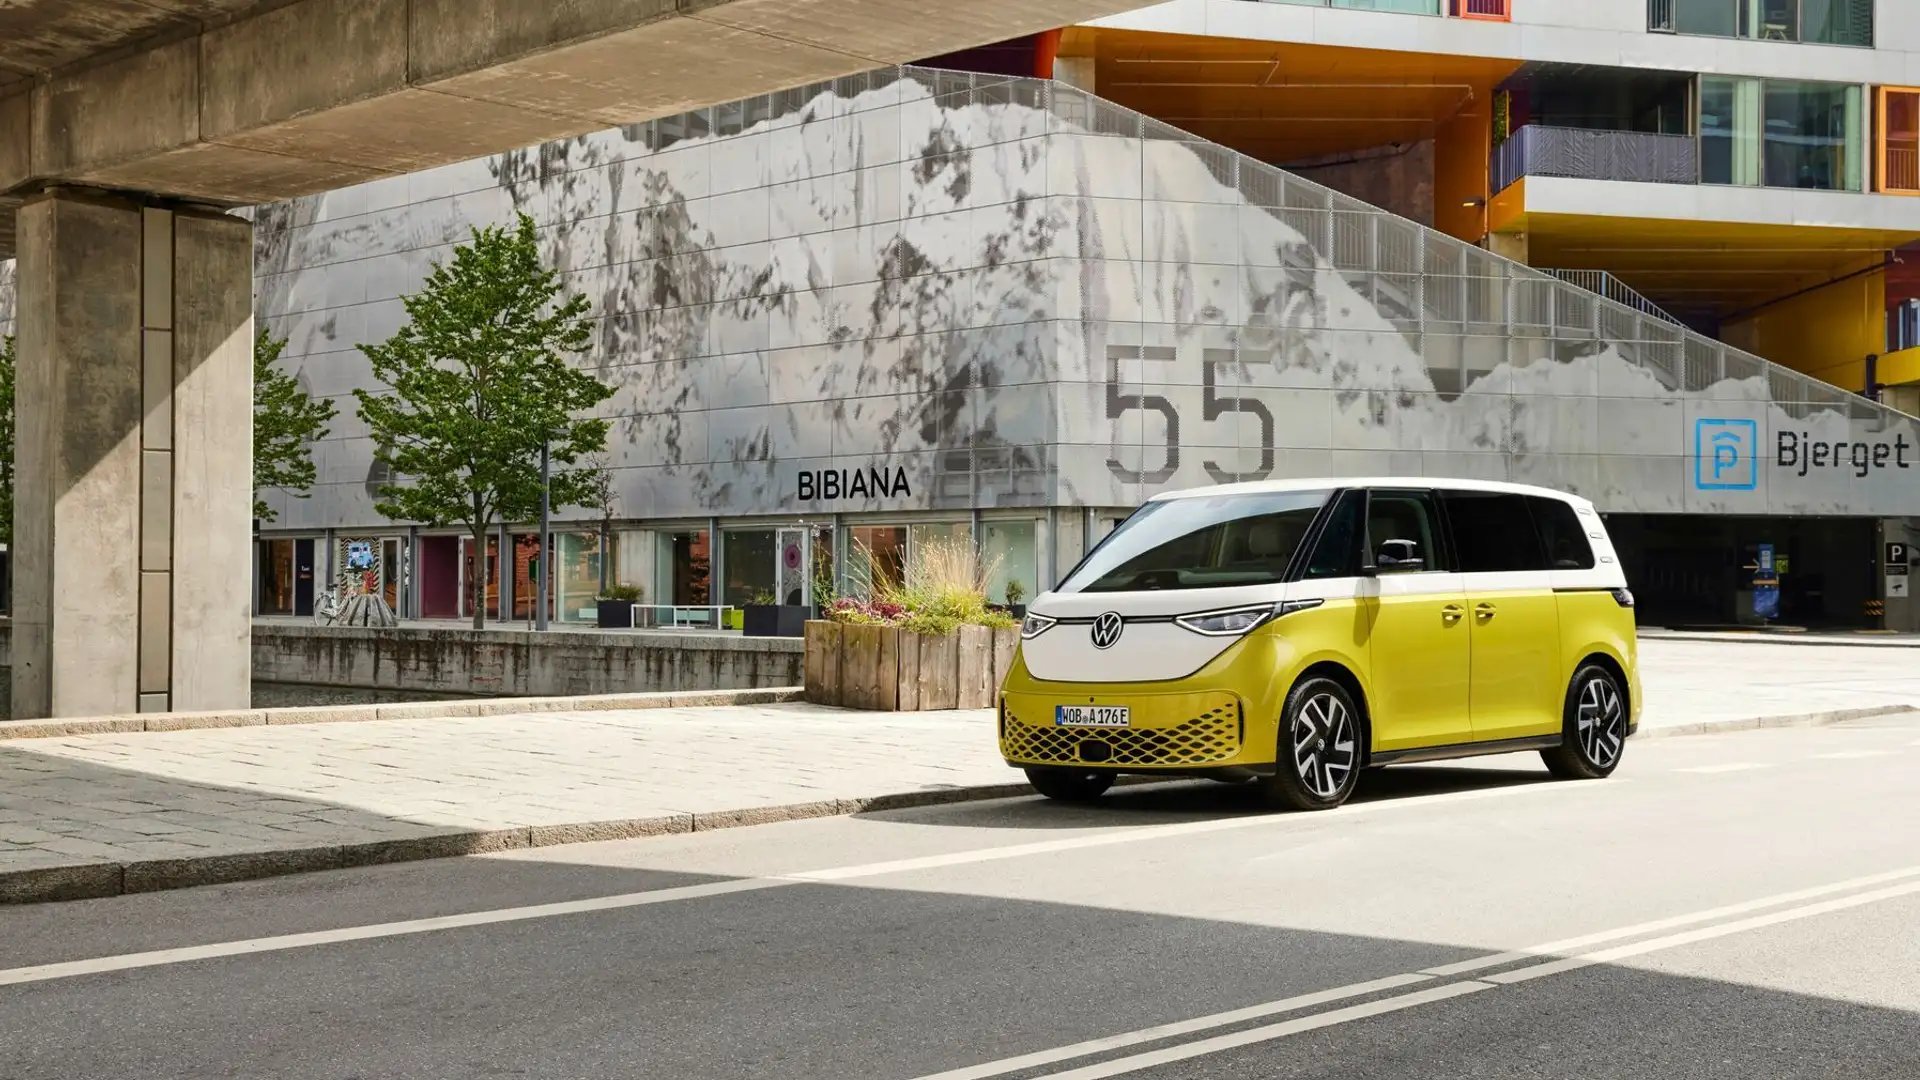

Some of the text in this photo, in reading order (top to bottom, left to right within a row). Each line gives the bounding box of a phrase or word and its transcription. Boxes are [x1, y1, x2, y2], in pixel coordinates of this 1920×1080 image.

[1106, 345, 1274, 484] 55
[1777, 431, 1909, 477] Bjerget
[798, 466, 911, 500] BIBIANA
[1891, 545, 1902, 561] P
[1062, 708, 1082, 723] WOB
